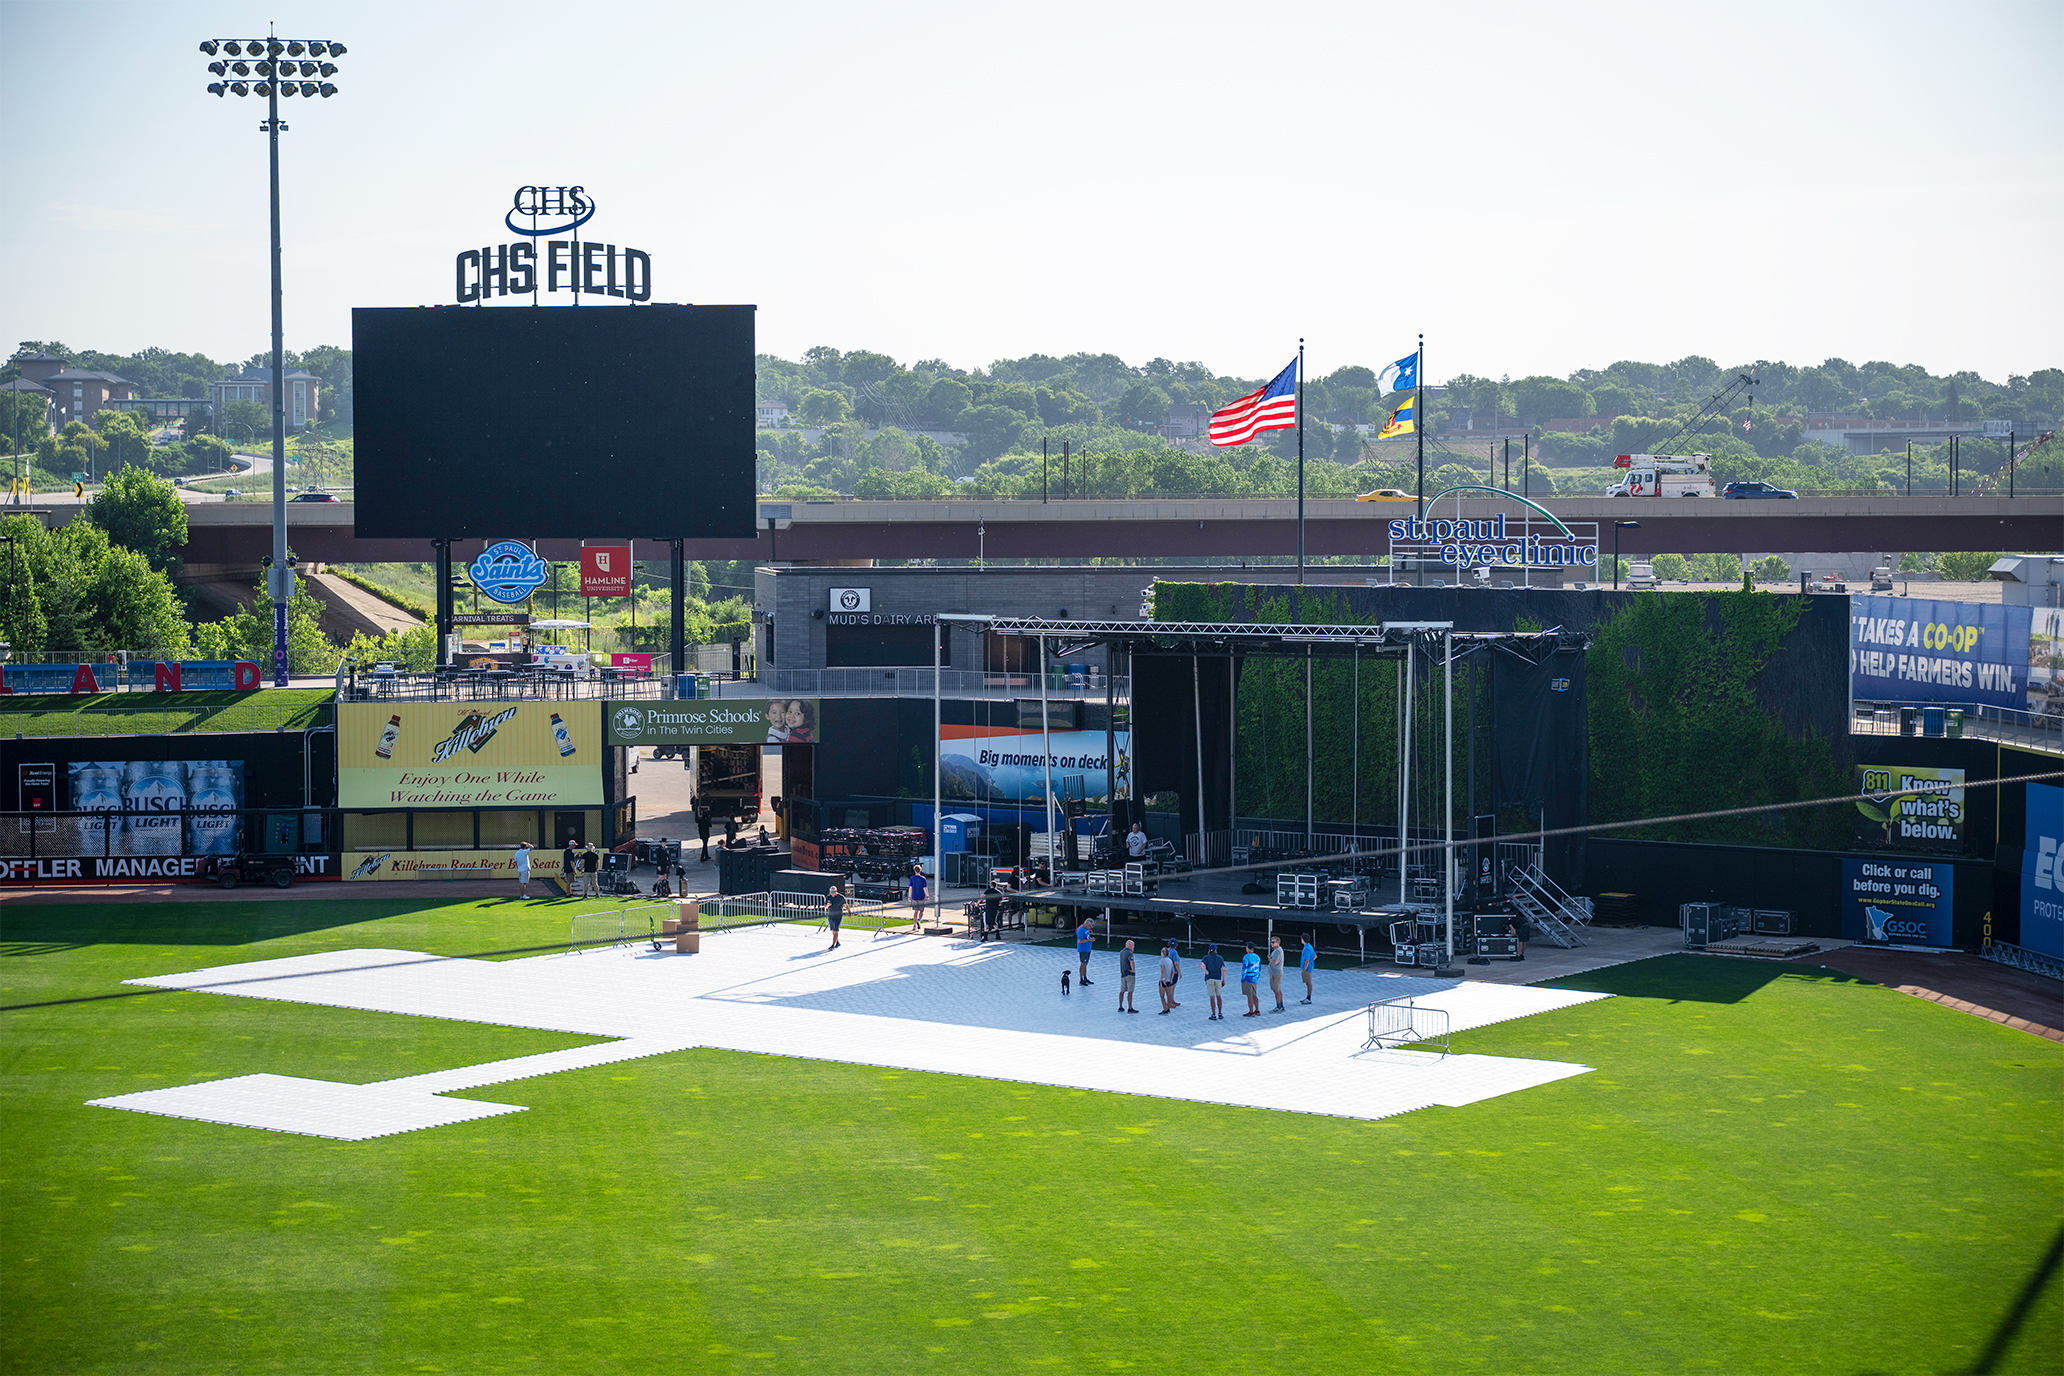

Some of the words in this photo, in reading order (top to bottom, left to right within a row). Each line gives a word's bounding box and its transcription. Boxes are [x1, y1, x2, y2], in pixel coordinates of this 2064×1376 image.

[514, 185, 587, 216] CHS
[456, 242, 534, 303] CHS
[548, 240, 651, 302] FIELD
[504, 544, 522, 556] PAUL
[471, 554, 547, 584] Saints
[584, 577, 626, 585] HAMLINE
[492, 586, 526, 599] BASEBALL
[452, 615, 486, 623] ARNIVAL
[829, 614, 869, 625] MUD'S
[873, 614, 912, 625] DAIRY
[914, 614, 939, 625] ARE
[1858, 616, 1905, 646] TAKES
[1906, 620, 1919, 648] A
[1860, 649, 1896, 678] HELP
[1898, 654, 1973, 689] FARMERS
[1977, 662, 2016, 693] WIN.
[647, 709, 707, 724] Primrose
[431, 706, 518, 764] Killebrew
[647, 725, 656, 735] in
[659, 725, 678, 735] The
[681, 725, 703, 734] Twin
[705, 725, 733, 734] Cities
[979, 749, 999, 767] Big
[1060, 755, 1076, 769] on
[398, 772, 452, 789] Enjoy
[454, 771, 491, 784] One
[496, 771, 546, 784] While
[1866, 772, 1888, 790] 811
[1901, 776, 1950, 795] Know
[124, 796, 189, 814] BUSCH
[391, 790, 472, 806] Watching
[474, 789, 502, 801] the
[505, 789, 557, 801] Game
[1901, 799, 1960, 818] what's
[135, 817, 179, 828] LIGHT
[196, 820, 230, 829] LIGHT
[1901, 819, 1958, 840] below.
[391, 859, 448, 872] Killebrew
[450, 858, 477, 870] Root
[480, 858, 505, 870] Beer
[532, 857, 561, 869] Seats
[1862, 863, 1892, 878] Click
[1894, 868, 1907, 878] or
[1910, 867, 1932, 880] call
[1853, 878, 1891, 893] before
[1894, 884, 1915, 896] you
[1918, 883, 1941, 898] dig.
[2034, 899, 2064, 922] PROTE
[1887, 920, 1927, 934] GSOC
